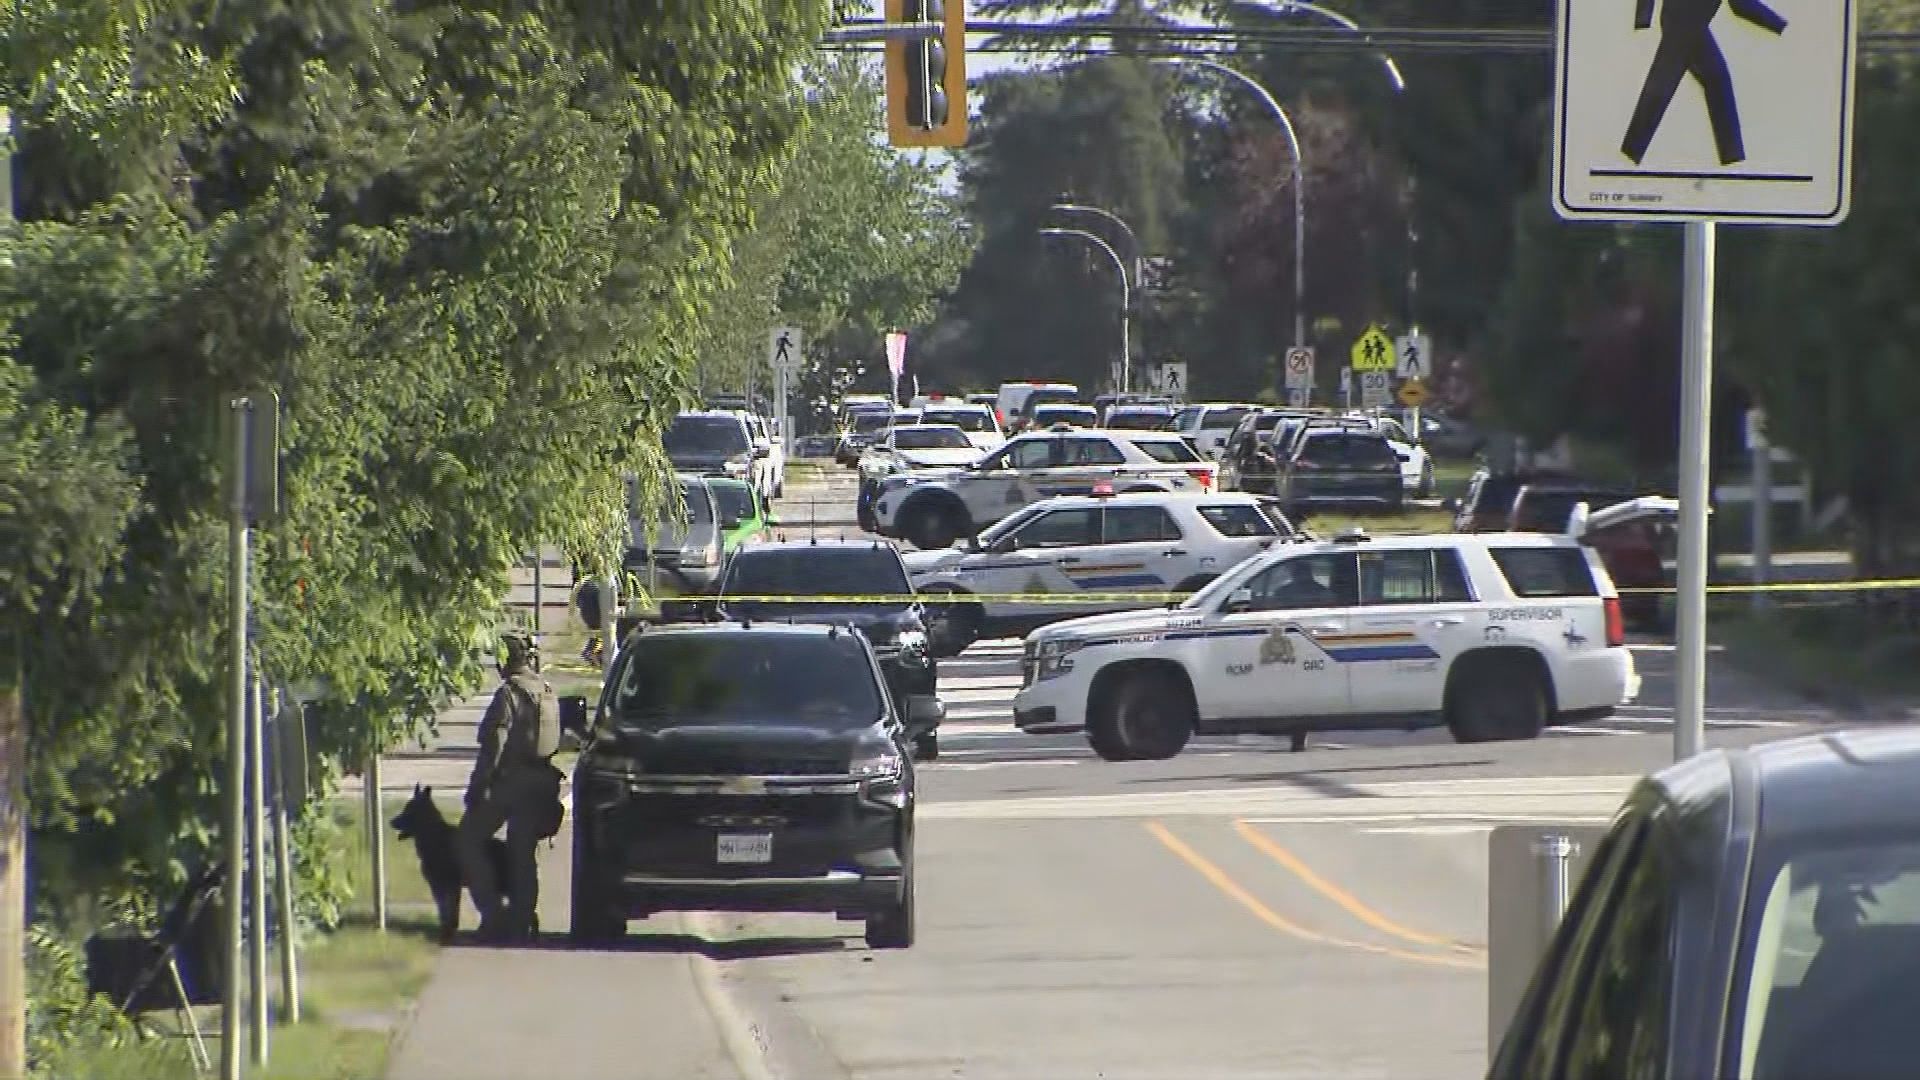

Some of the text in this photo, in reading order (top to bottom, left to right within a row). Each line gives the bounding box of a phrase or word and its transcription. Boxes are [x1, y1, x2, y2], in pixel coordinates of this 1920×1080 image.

[1590, 192, 1609, 201] CITY
[1487, 608, 1563, 621] SUPERVISOR
[1225, 663, 1254, 676] RCMP
